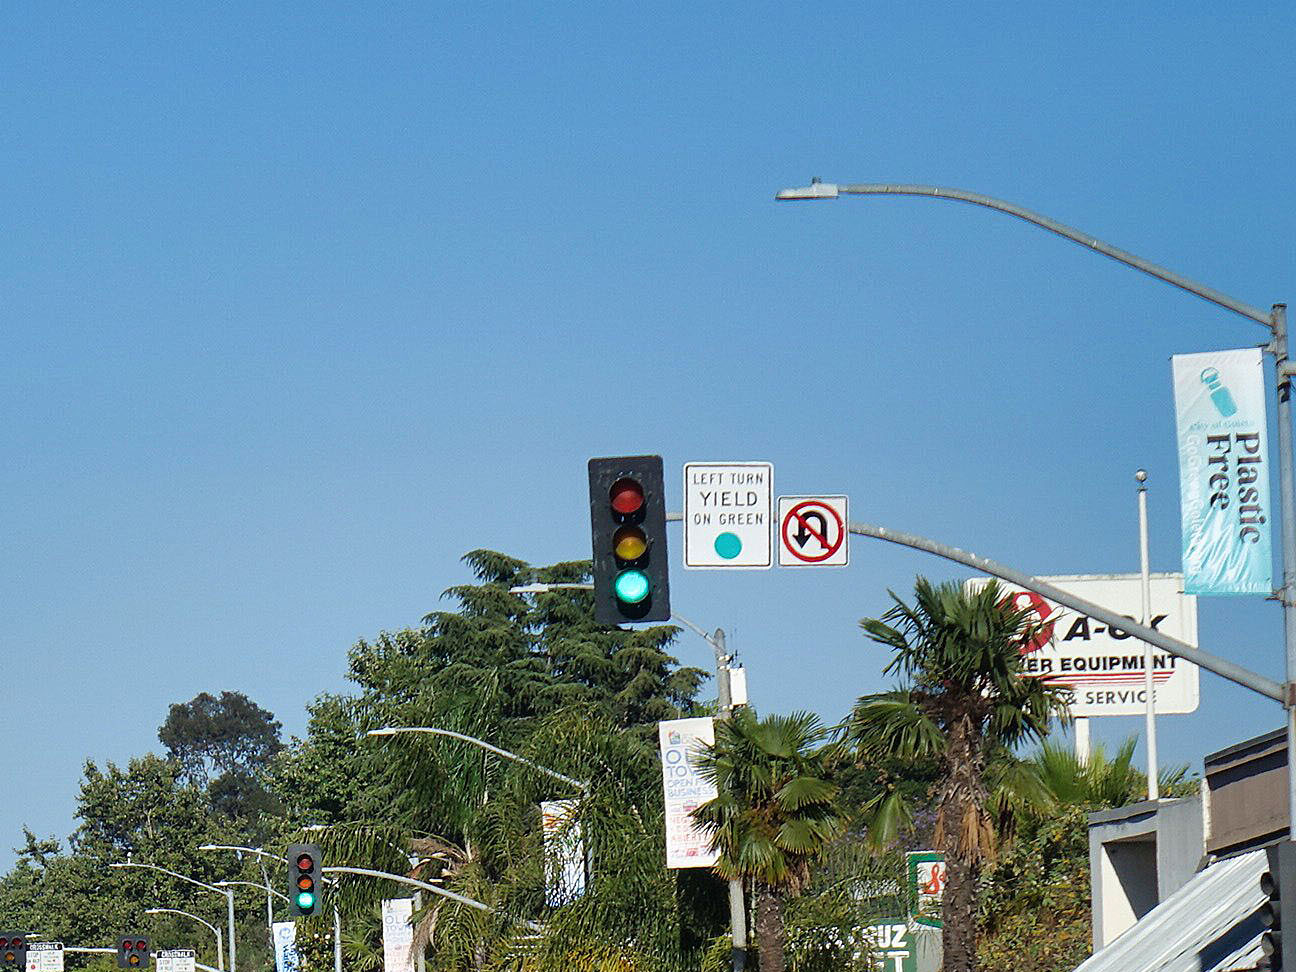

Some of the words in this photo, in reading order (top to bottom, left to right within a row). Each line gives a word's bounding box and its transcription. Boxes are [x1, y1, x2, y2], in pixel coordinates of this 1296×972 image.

[693, 472, 723, 485] LEFT
[730, 472, 763, 485] TURN
[1206, 432, 1231, 510] Free
[1236, 431, 1266, 545] Plastic
[700, 491, 758, 507] YIELD
[693, 513, 711, 525] ON
[719, 513, 763, 525] GREEN
[1021, 658, 1052, 672] ER
[1061, 654, 1177, 672] EQUIPMNT
